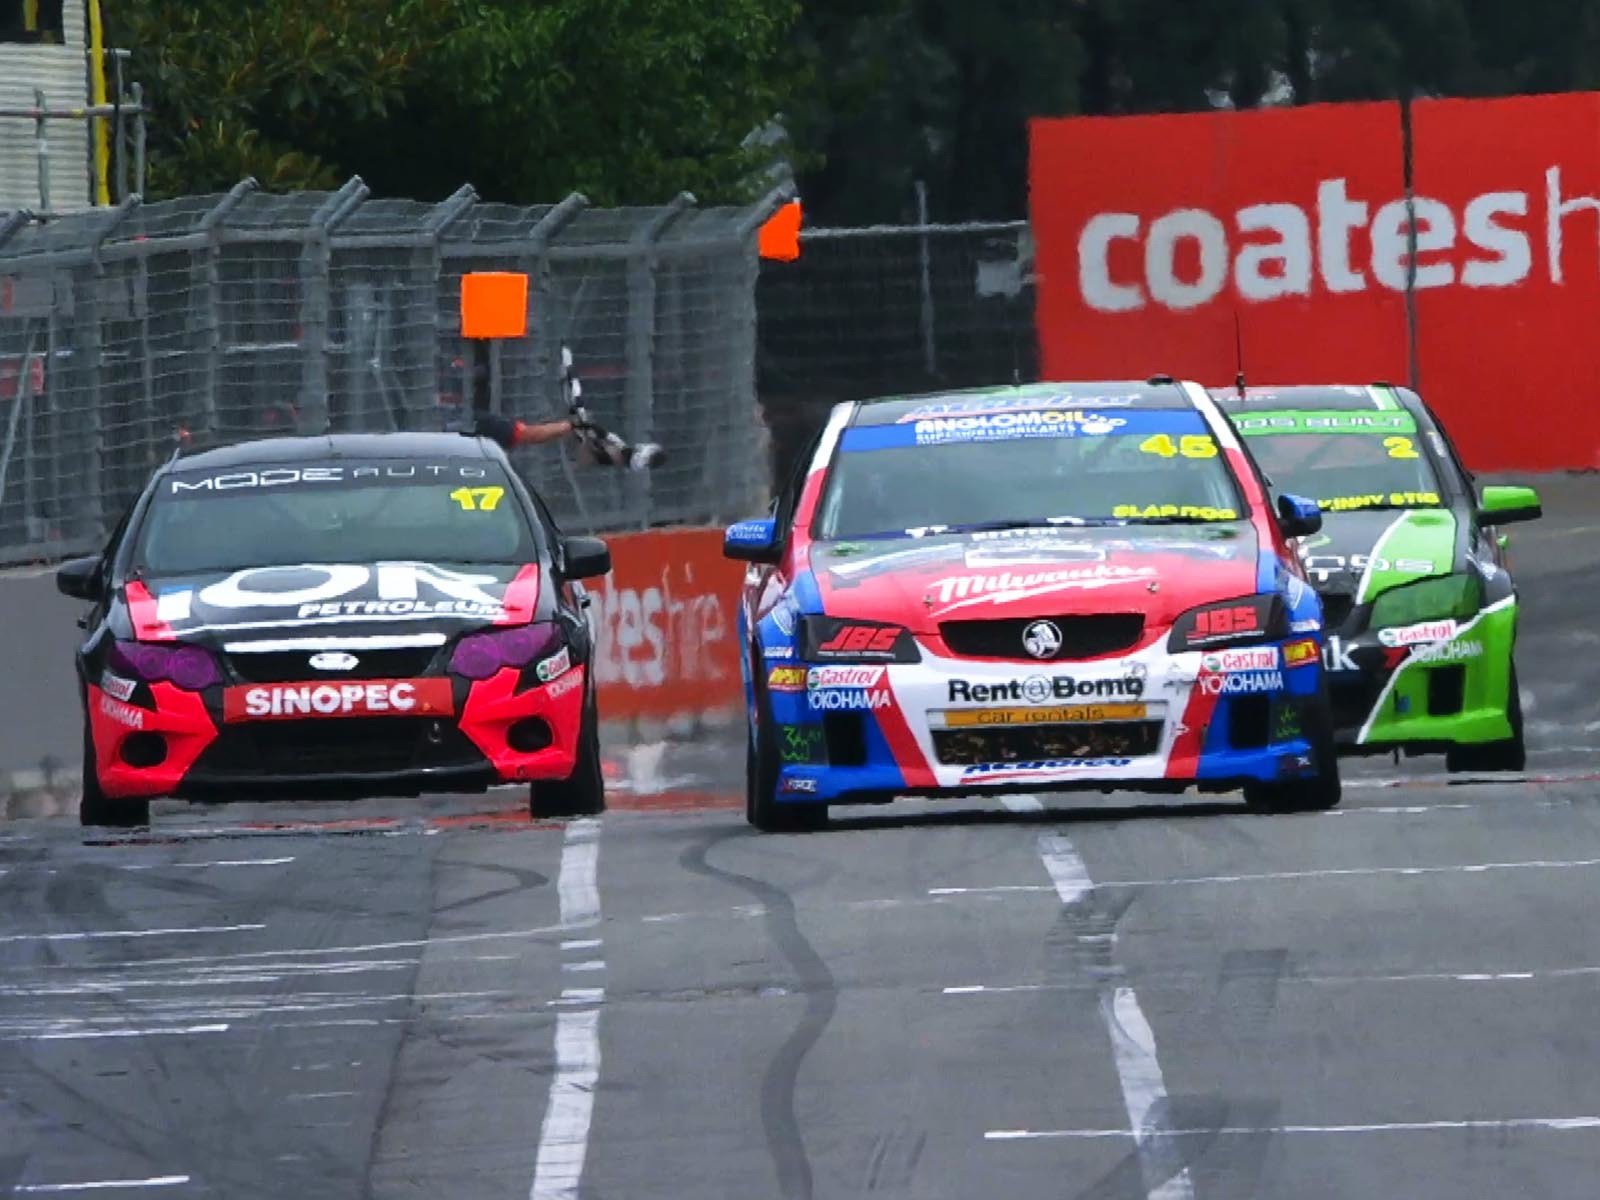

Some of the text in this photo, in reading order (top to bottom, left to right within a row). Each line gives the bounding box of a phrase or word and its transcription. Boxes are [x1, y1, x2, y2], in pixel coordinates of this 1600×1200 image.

[1383, 436, 1420, 458] 2
[172, 465, 487, 494] MODE AUTO
[450, 487, 504, 511] 17
[298, 597, 504, 618] PETROLEUM
[819, 626, 902, 651] JBS
[820, 667, 877, 685] Castrol
[1199, 671, 1284, 696] YOKOHAMA
[245, 682, 417, 716] SINOPEC
[807, 689, 891, 710] YOKOHAMA
